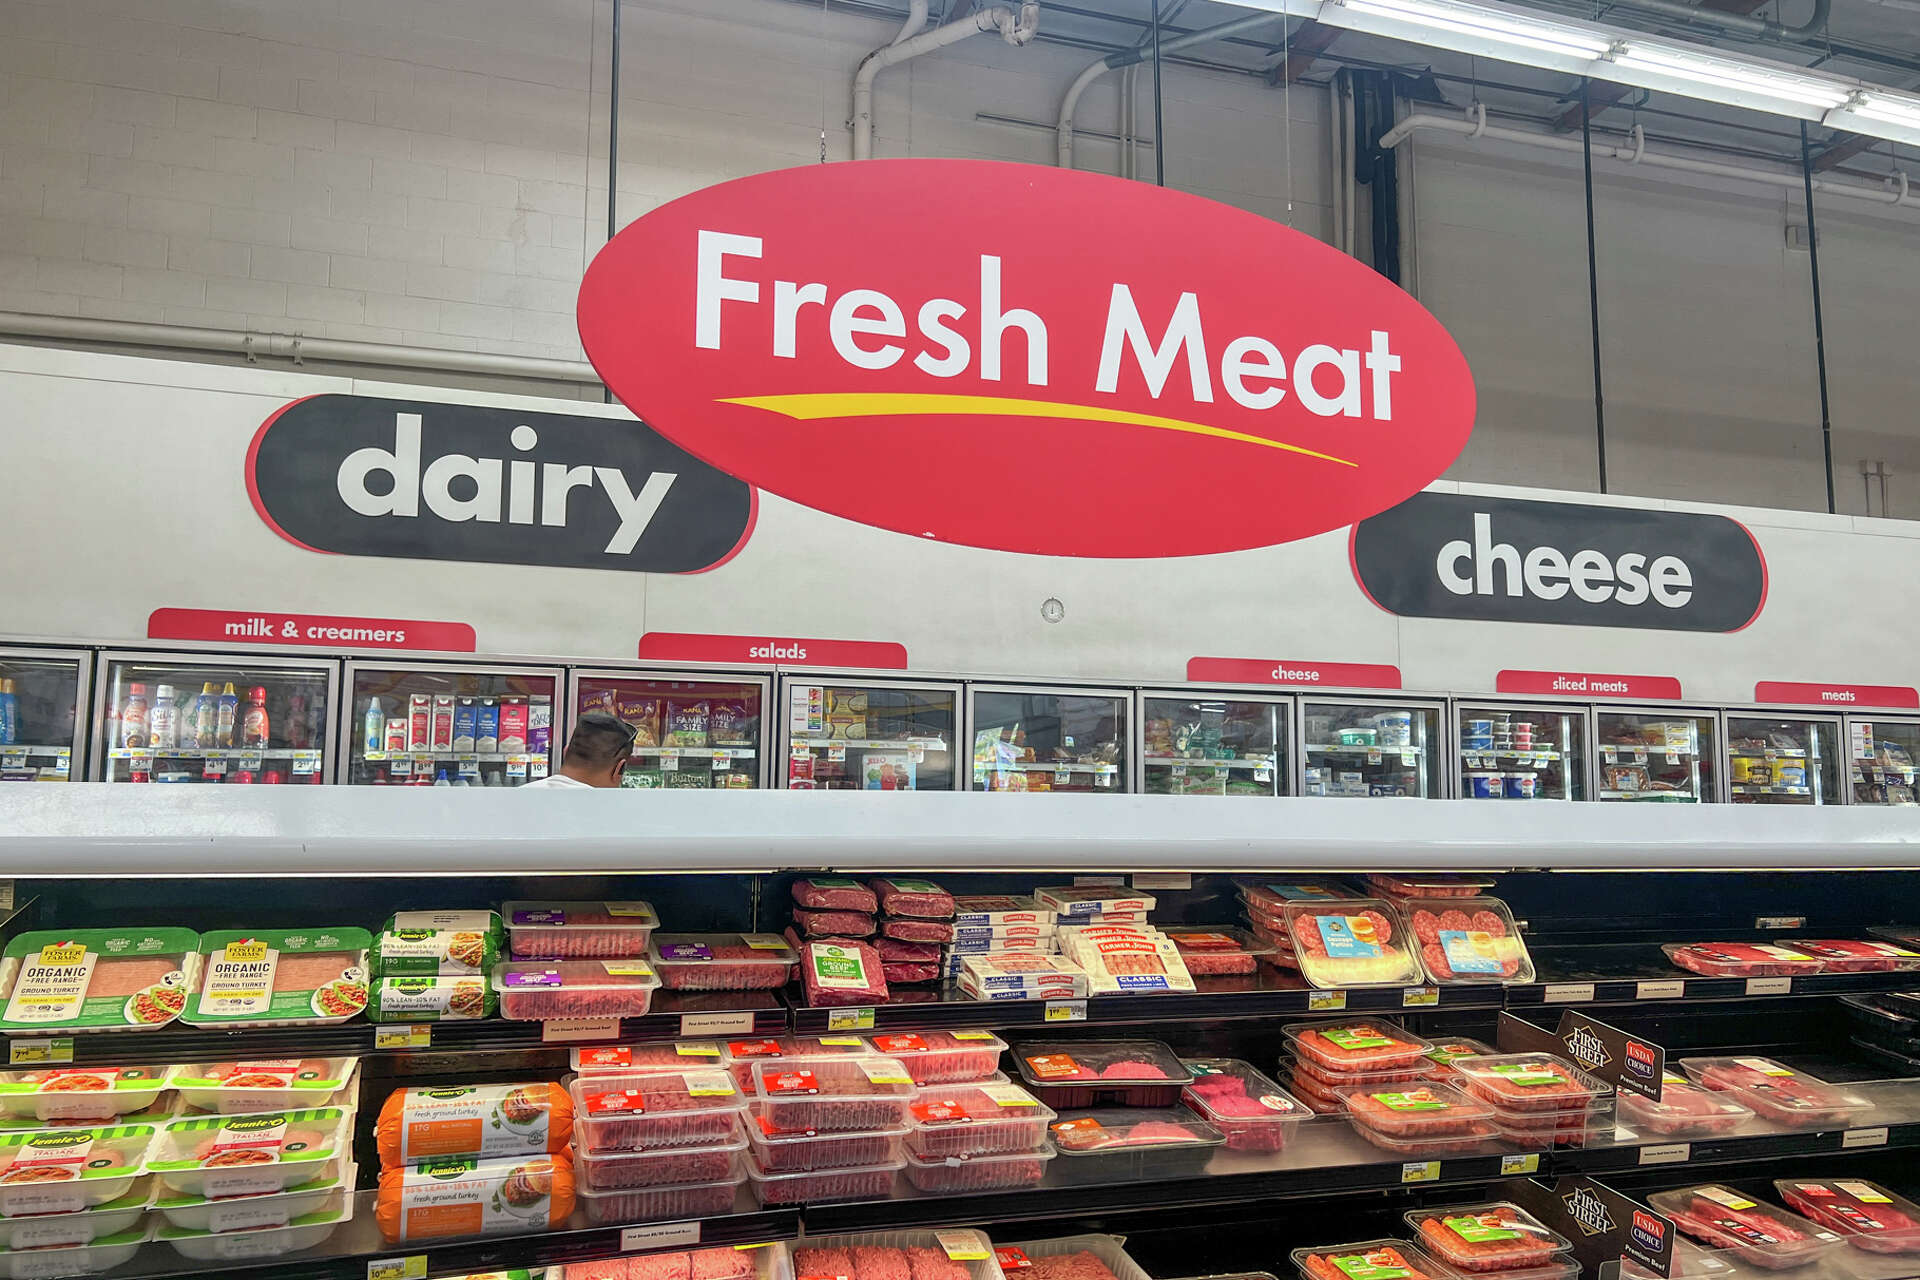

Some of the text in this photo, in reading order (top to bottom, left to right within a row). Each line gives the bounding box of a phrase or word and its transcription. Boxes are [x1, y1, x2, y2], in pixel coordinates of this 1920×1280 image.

[694, 229, 1402, 422] Fresh Meat
[336, 412, 678, 555] dairy
[1436, 512, 1693, 609] cheese
[225, 618, 406, 643] milk & creamers
[748, 643, 808, 661] salads
[1270, 665, 1321, 682] cheese
[1552, 676, 1629, 694] sliced meats
[1821, 690, 1856, 702] meats
[675, 715, 709, 725] FAMILY
[711, 713, 736, 723] AMILY
[682, 723, 702, 732] SIZE
[43, 949, 82, 957] FOSTER
[1100, 942, 1153, 951] FARMER JOHN
[27, 967, 87, 978] ORGANIC
[215, 963, 271, 973] ORGANIC
[52, 976, 79, 984] RANGE
[1573, 1026, 1604, 1053] FIRST
[1568, 1039, 1607, 1068] STREET
[1629, 1046, 1650, 1063] USDA
[1627, 1057, 1652, 1075] CHOICE
[1620, 1073, 1657, 1096] Premium Beef
[414, 1107, 479, 1119] fresh ground turkey
[413, 1191, 480, 1204] fresh ground turkey
[1574, 1186, 1608, 1218] FIRST
[1567, 1199, 1611, 1234] STREET
[1636, 1215, 1660, 1235] USDA
[1633, 1227, 1661, 1250] CHOICE
[1624, 1243, 1666, 1272] Premium Beef
